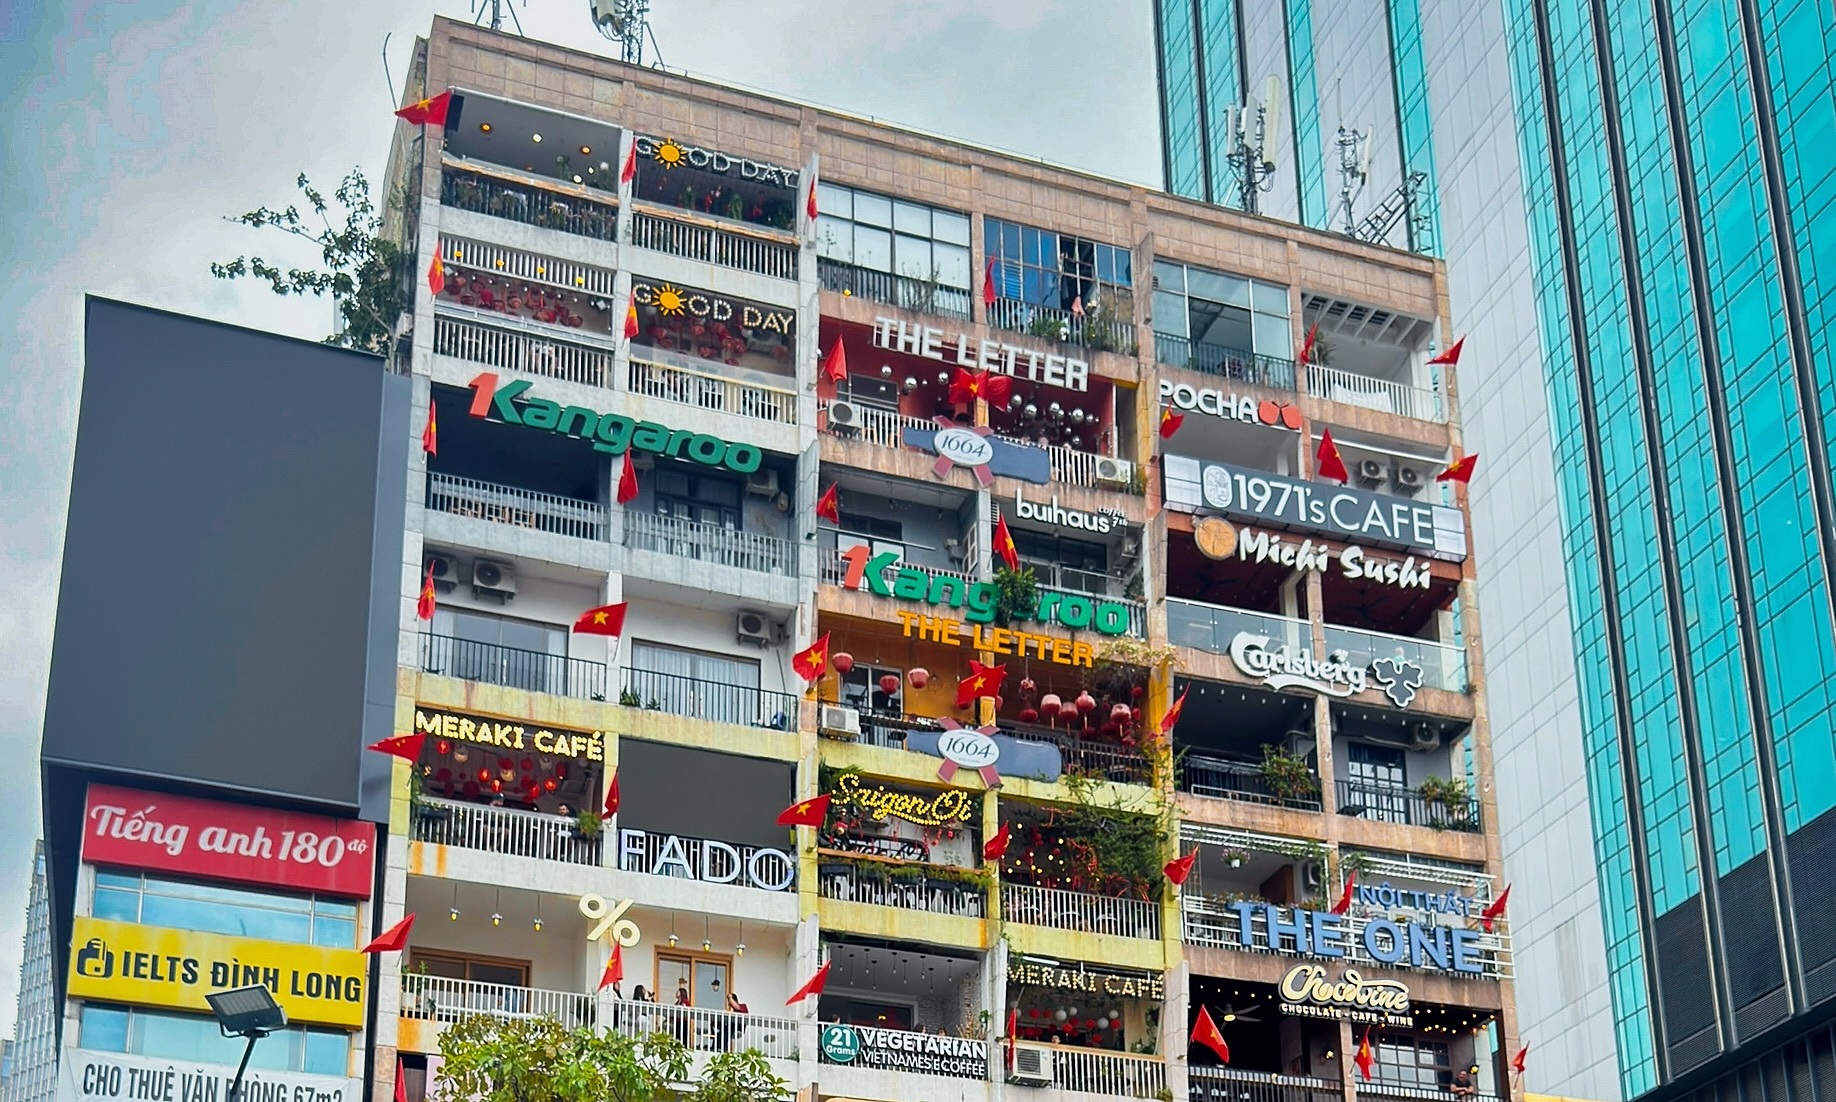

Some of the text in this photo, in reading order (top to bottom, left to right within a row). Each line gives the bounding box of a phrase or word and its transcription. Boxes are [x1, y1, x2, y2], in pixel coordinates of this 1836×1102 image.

[743, 306, 793, 335] DAY
[873, 316, 1088, 392] THE LETTER
[1159, 379, 1259, 423] POCHA
[942, 435, 987, 457] 1664
[1016, 487, 1110, 533] buihaus
[1233, 474, 1434, 545] 1971's CAFE
[1239, 527, 1432, 590] Michi Sushi
[897, 610, 1094, 668] THE LETTER
[1230, 631, 1367, 697] Carlsberg
[415, 711, 603, 761] MERAKI CAFÉ
[946, 736, 995, 758] 1664
[831, 773, 941, 825] Saigon
[91, 805, 189, 856] Tiếng
[198, 826, 272, 859] anh
[278, 831, 344, 867] 180
[620, 828, 795, 891] FADO
[1359, 882, 1402, 910] NỘI
[1227, 902, 1484, 973] THE ONE
[122, 951, 361, 1002] IELTS ĐÌNH LONG
[1007, 963, 1164, 1000] MERAKI CAFÉ
[831, 1028, 850, 1046] 21
[1281, 1003, 1413, 1026] CHOCOLATE CAFE WINE
[826, 1045, 856, 1056] Grams
[860, 1029, 987, 1060] VEGETARIAN
[861, 1048, 985, 1076] VIETNAMESE COFFEE
[83, 1064, 122, 1097] CHO
[129, 1066, 175, 1101] THUÊ
[182, 1069, 219, 1102] VĂN
